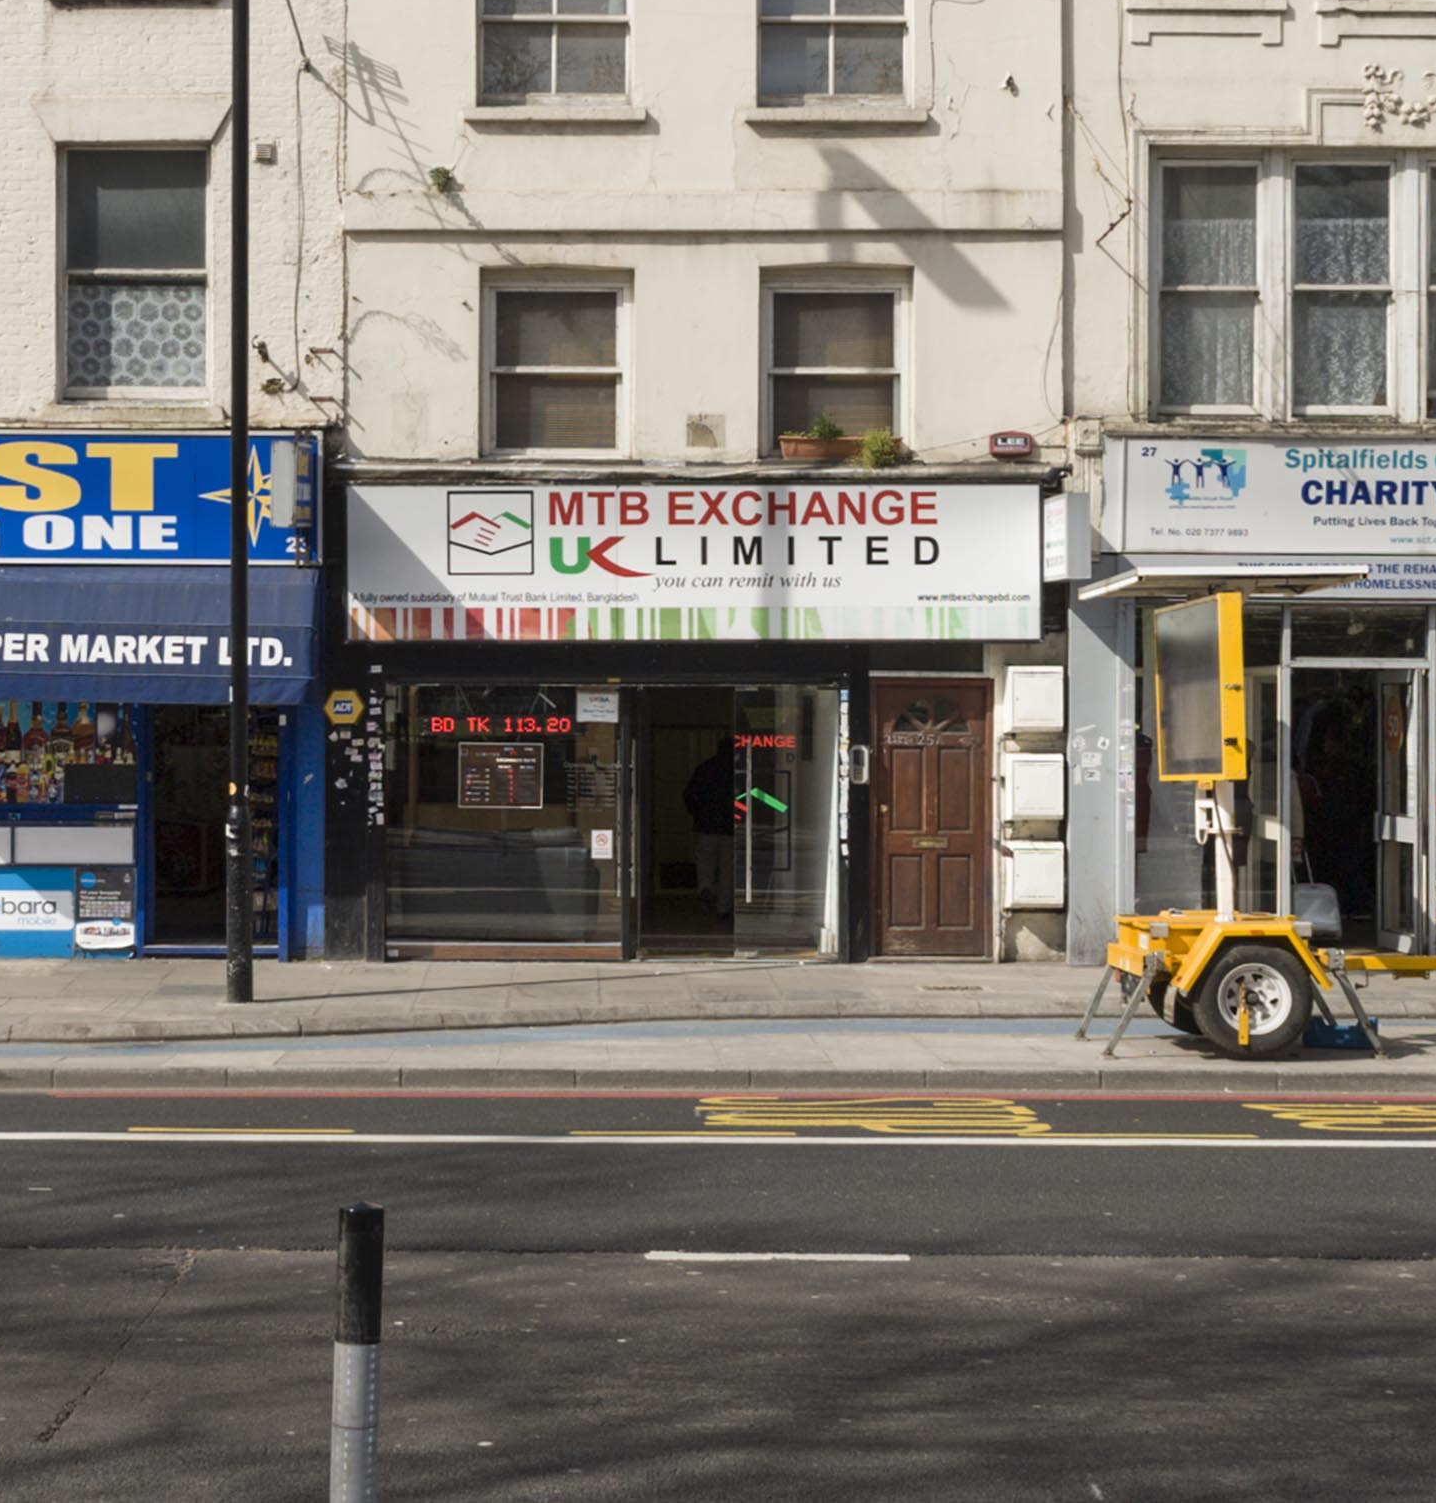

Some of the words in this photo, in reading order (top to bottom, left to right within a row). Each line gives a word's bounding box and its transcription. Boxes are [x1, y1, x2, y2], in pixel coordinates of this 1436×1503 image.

[1141, 447, 1157, 457] 27
[1285, 448, 1428, 472] Spitalfields
[549, 491, 649, 526] MTB
[668, 490, 938, 526] EXCHANGE
[1313, 516, 1354, 528] Putting
[1358, 516, 1386, 527] Lives
[1389, 516, 1418, 527] Back
[22, 514, 178, 550] ONE
[549, 536, 656, 578] UK
[656, 535, 940, 565] LIMITED
[1377, 564, 1400, 574] THE
[654, 575, 686, 592] you
[691, 576, 723, 588] can
[729, 572, 774, 588] remit
[780, 572, 816, 588] with
[823, 576, 842, 588] us
[380, 593, 409, 602] owned
[412, 592, 455, 604] subsidiary
[457, 592, 466, 602] of
[469, 592, 498, 602] Mutual
[501, 592, 523, 602] Trust
[525, 592, 547, 602] Bank
[587, 592, 639, 604] Bangladesh
[59, 634, 208, 665] MARKET
[218, 637, 293, 666] LTD.
[334, 702, 352, 713] ADT
[431, 716, 455, 732] BD
[467, 716, 490, 732] TK
[504, 716, 572, 733] 113.20
[17, 916, 56, 926] mobile
[696, 1096, 1052, 1135] STOP
